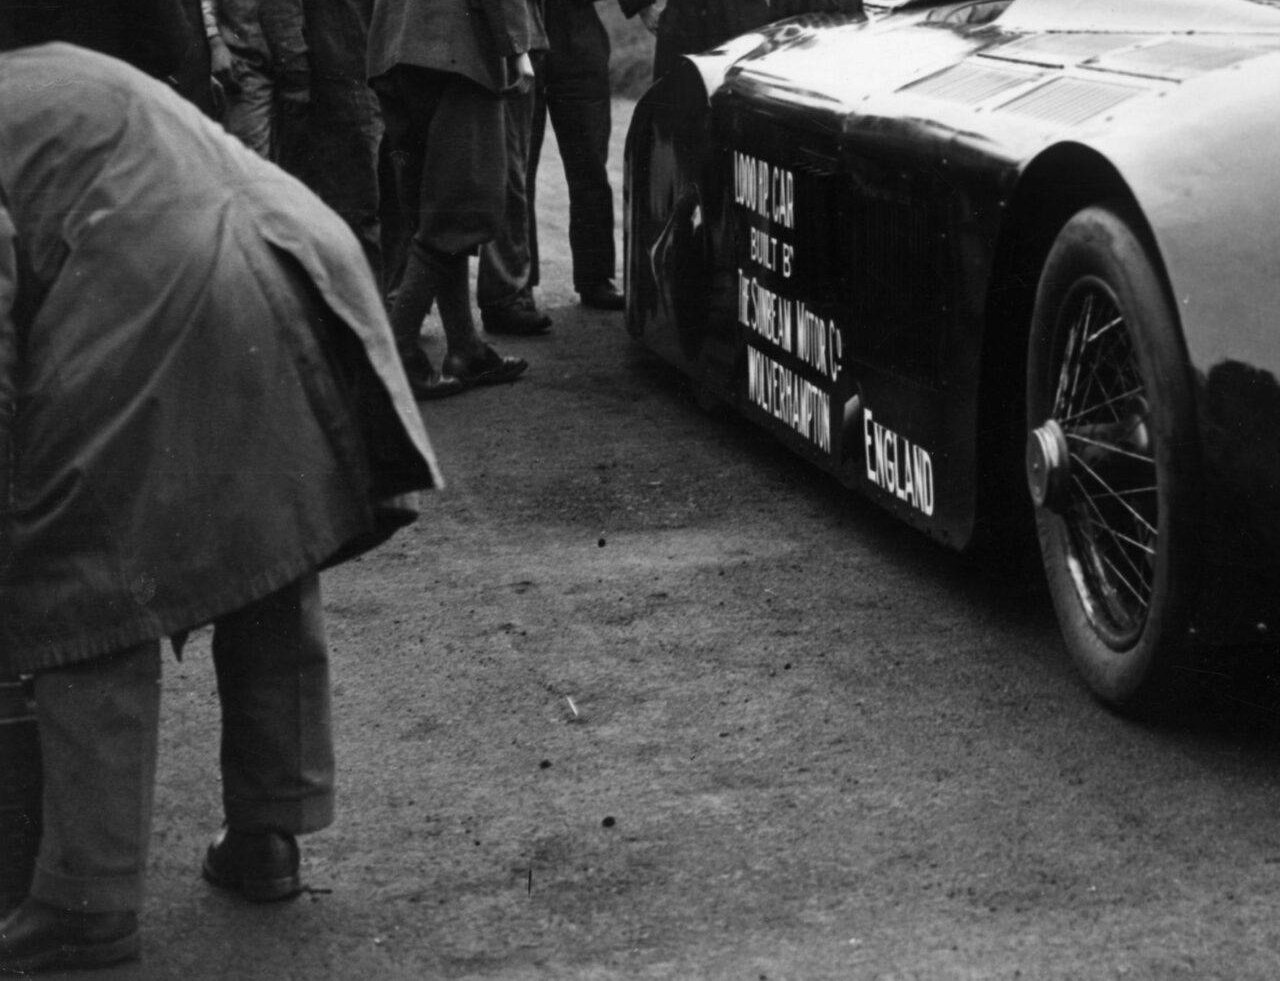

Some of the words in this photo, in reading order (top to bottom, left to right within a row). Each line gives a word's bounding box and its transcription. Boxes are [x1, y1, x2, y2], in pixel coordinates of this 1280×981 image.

[772, 166, 794, 229] CAR
[750, 226, 778, 272] BUILT
[751, 277, 792, 353] SUNBEAM
[796, 300, 827, 376] MOTOR
[747, 344, 831, 454] WOLVERHAMPTON
[863, 408, 934, 516] ENGLAND
